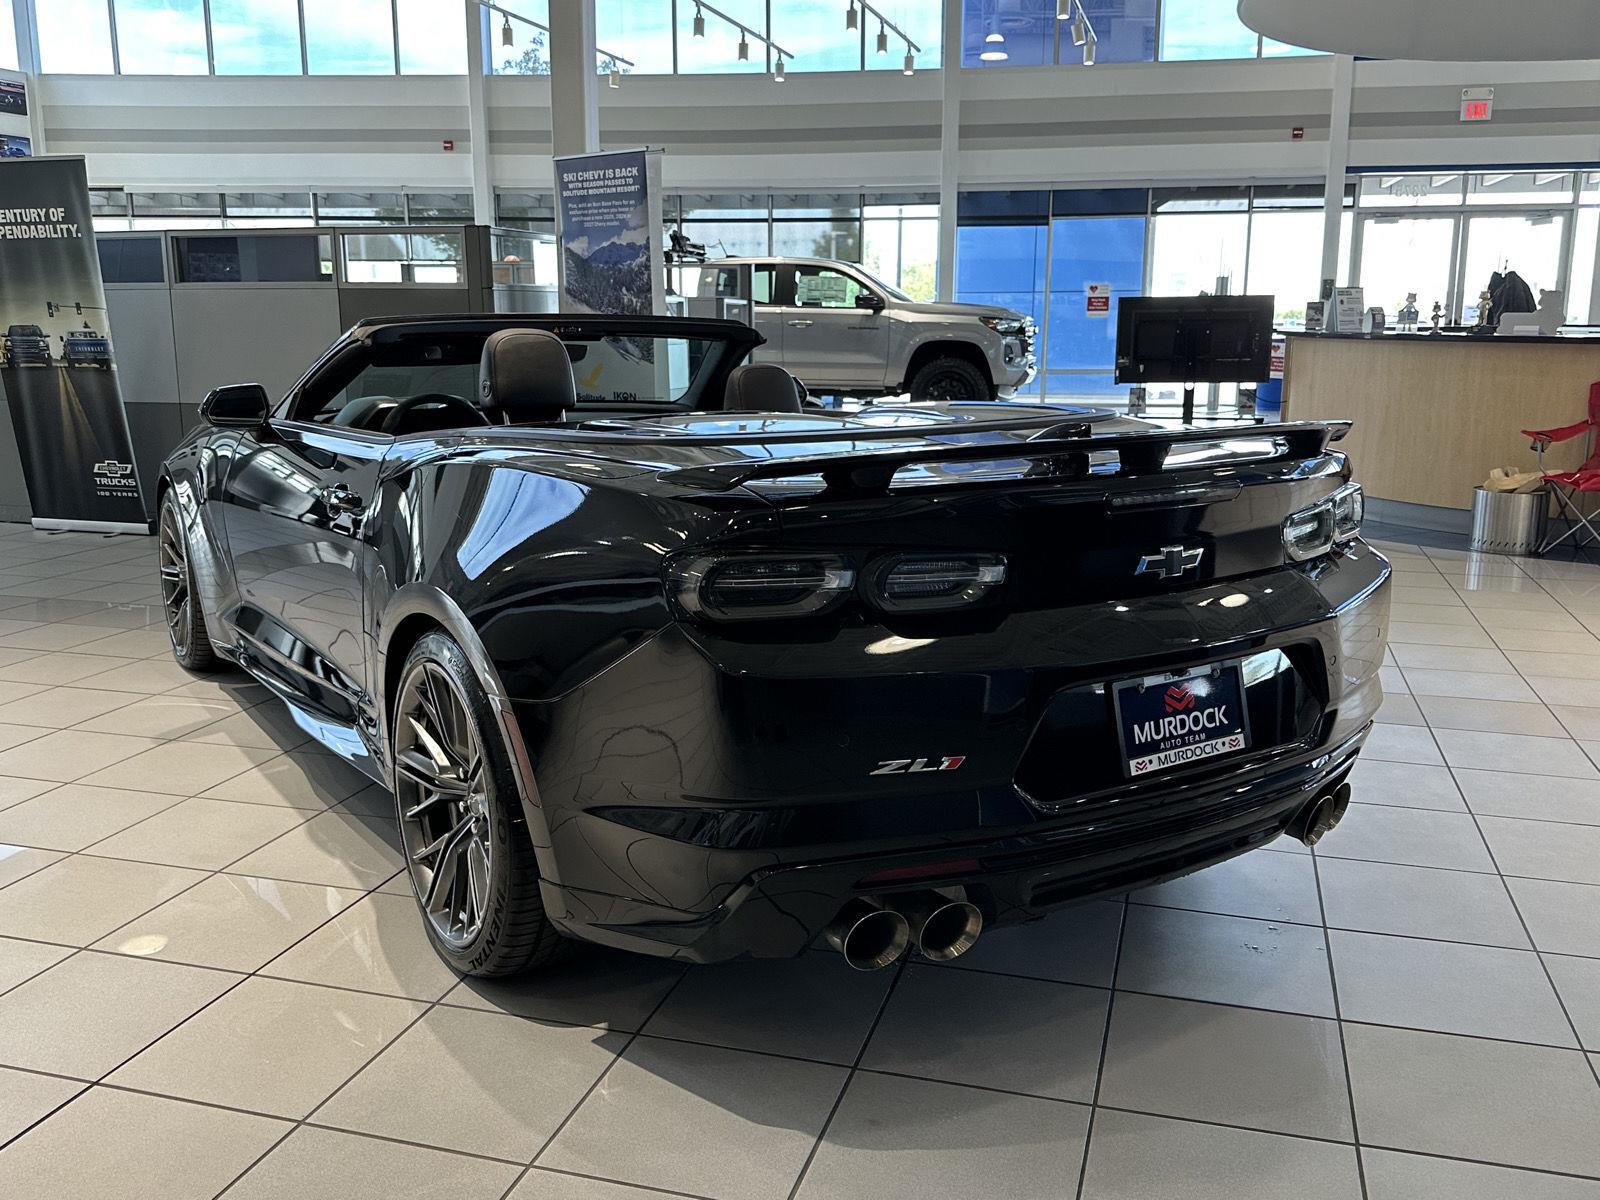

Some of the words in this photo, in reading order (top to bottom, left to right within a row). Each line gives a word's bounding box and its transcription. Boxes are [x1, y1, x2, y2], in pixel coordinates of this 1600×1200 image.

[563, 172, 576, 182] SKI
[578, 170, 604, 180] CHEVY
[606, 169, 614, 178] IS
[615, 167, 638, 178] BACK
[0, 208, 46, 222] ENTURY
[49, 208, 65, 222] OF
[0, 224, 82, 239] PENDABILITY.
[614, 392, 636, 400] IKON
[94, 478, 136, 486] TRUCKS
[1134, 705, 1228, 744] MURDOCK
[1160, 738, 1182, 750] AUTO
[1185, 732, 1206, 743] TEAM
[1158, 740, 1220, 767] MURDOCK
[870, 756, 966, 775] ZL1
